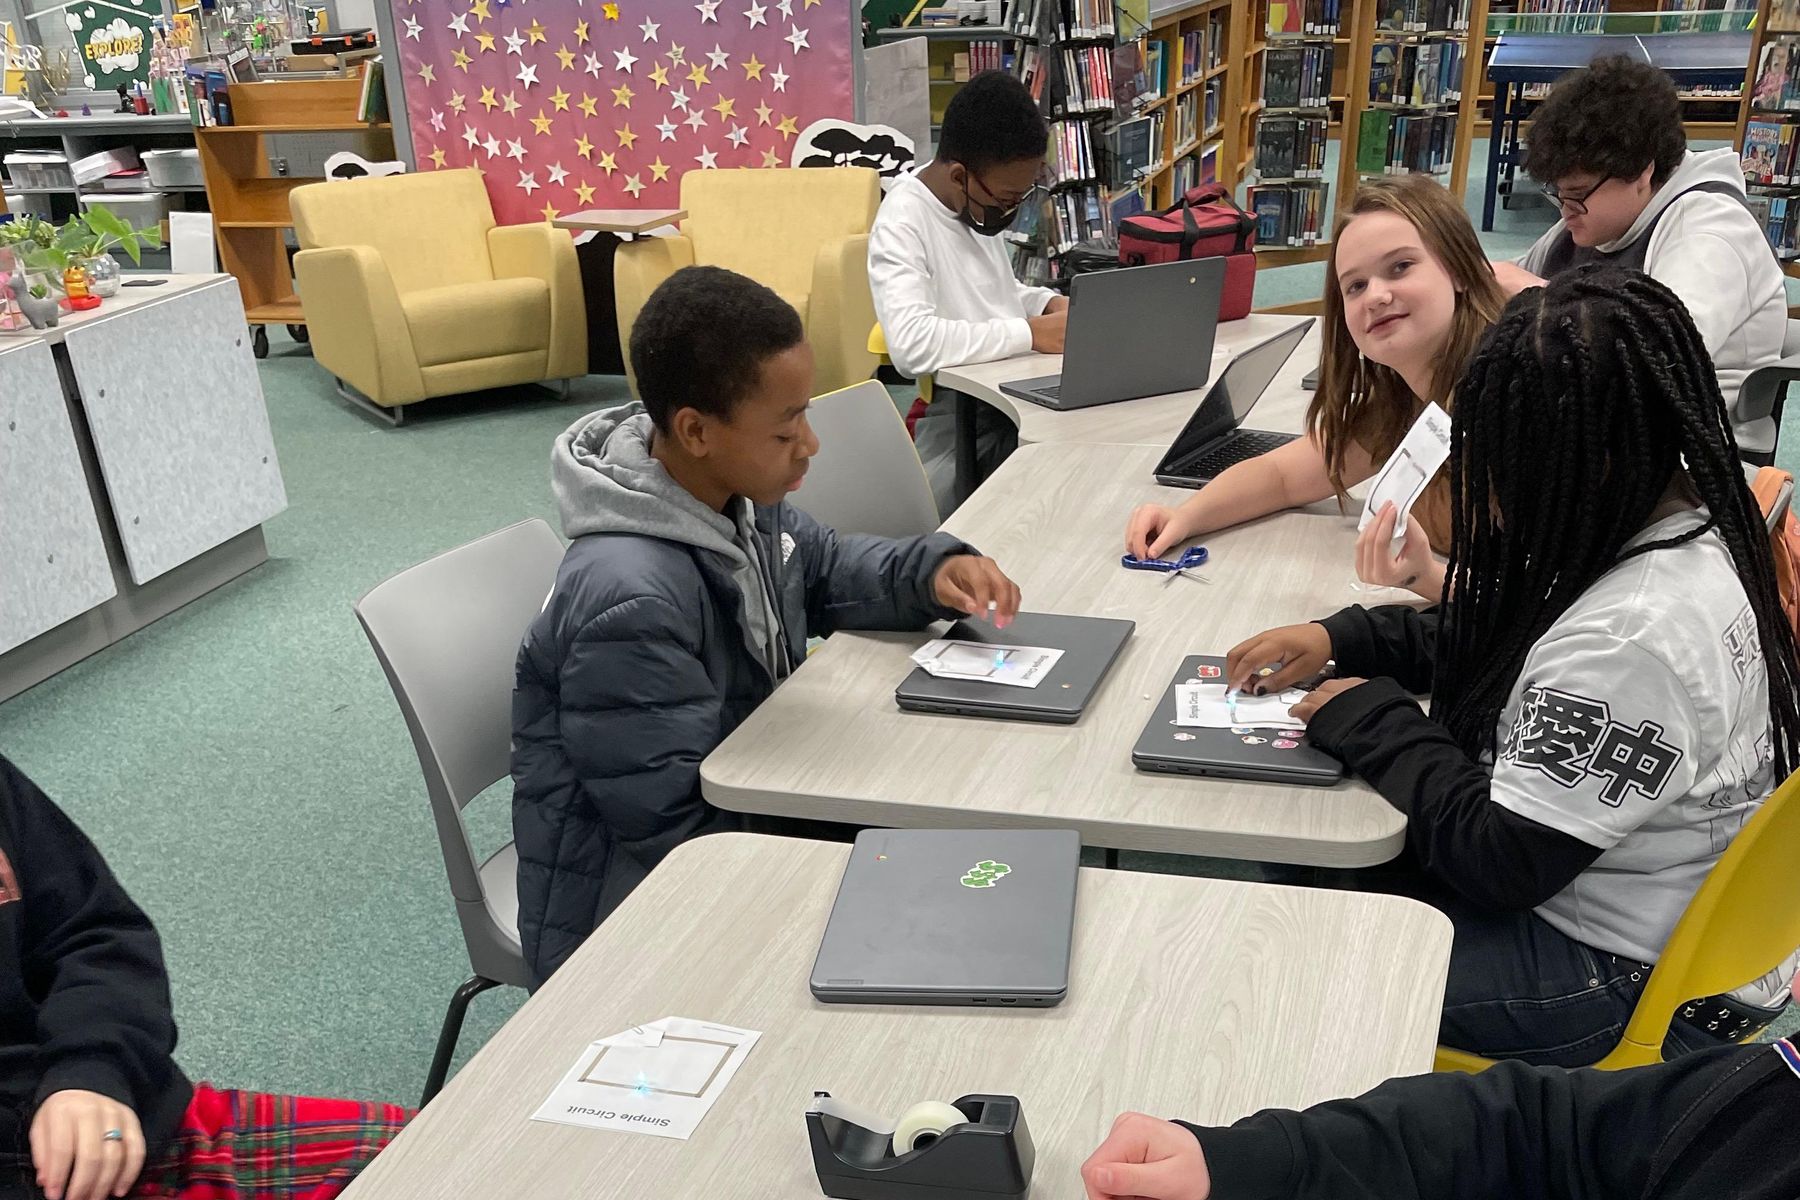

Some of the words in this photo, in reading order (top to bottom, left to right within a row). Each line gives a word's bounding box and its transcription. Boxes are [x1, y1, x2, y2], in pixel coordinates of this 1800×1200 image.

[84, 35, 144, 60] EXPLORE!
[567, 1105, 616, 1120] Circuit
[620, 1113, 671, 1127] Simple
